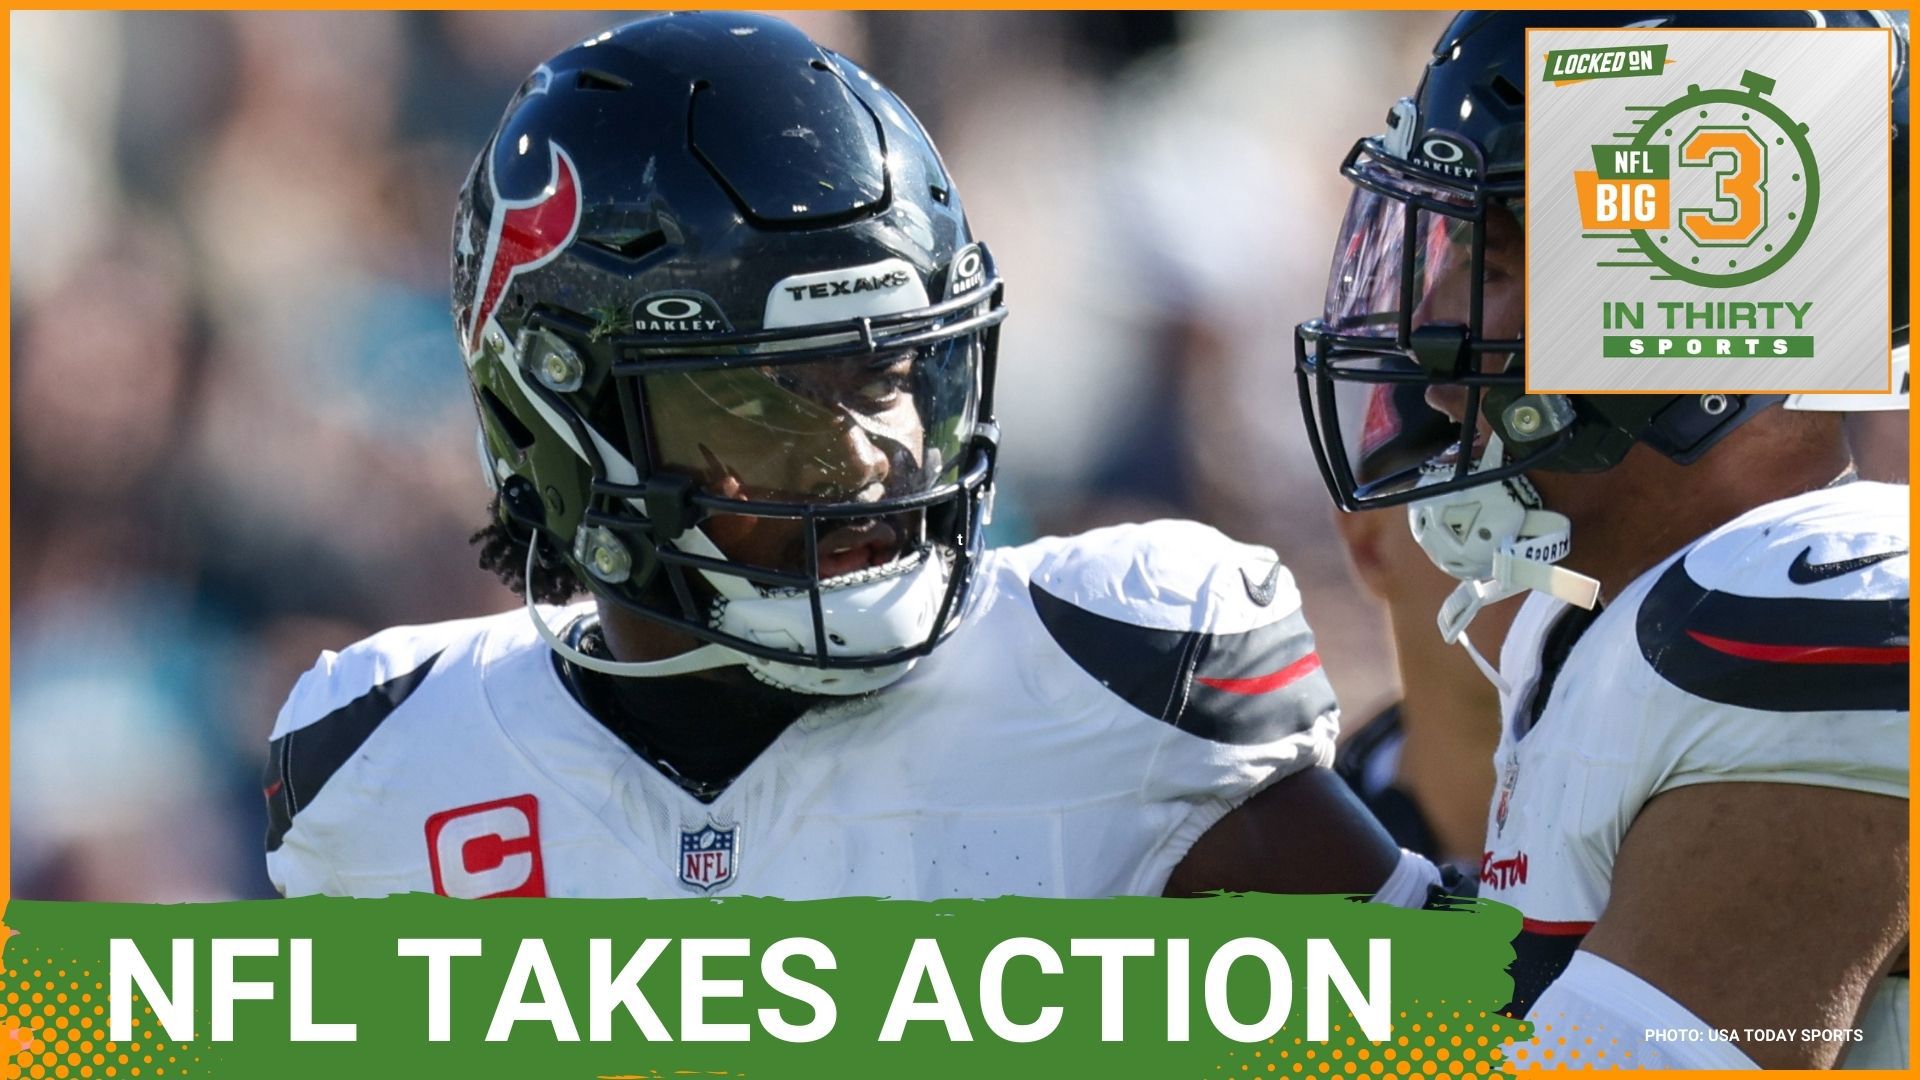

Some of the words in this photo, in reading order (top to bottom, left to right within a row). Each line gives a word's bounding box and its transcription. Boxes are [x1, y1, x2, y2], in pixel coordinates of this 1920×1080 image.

[1413, 158, 1474, 178] OAKLEY
[785, 270, 909, 301] TEXANS
[635, 320, 716, 331] OAKLEY
[436, 805, 533, 899] C
[686, 852, 728, 882] NFL
